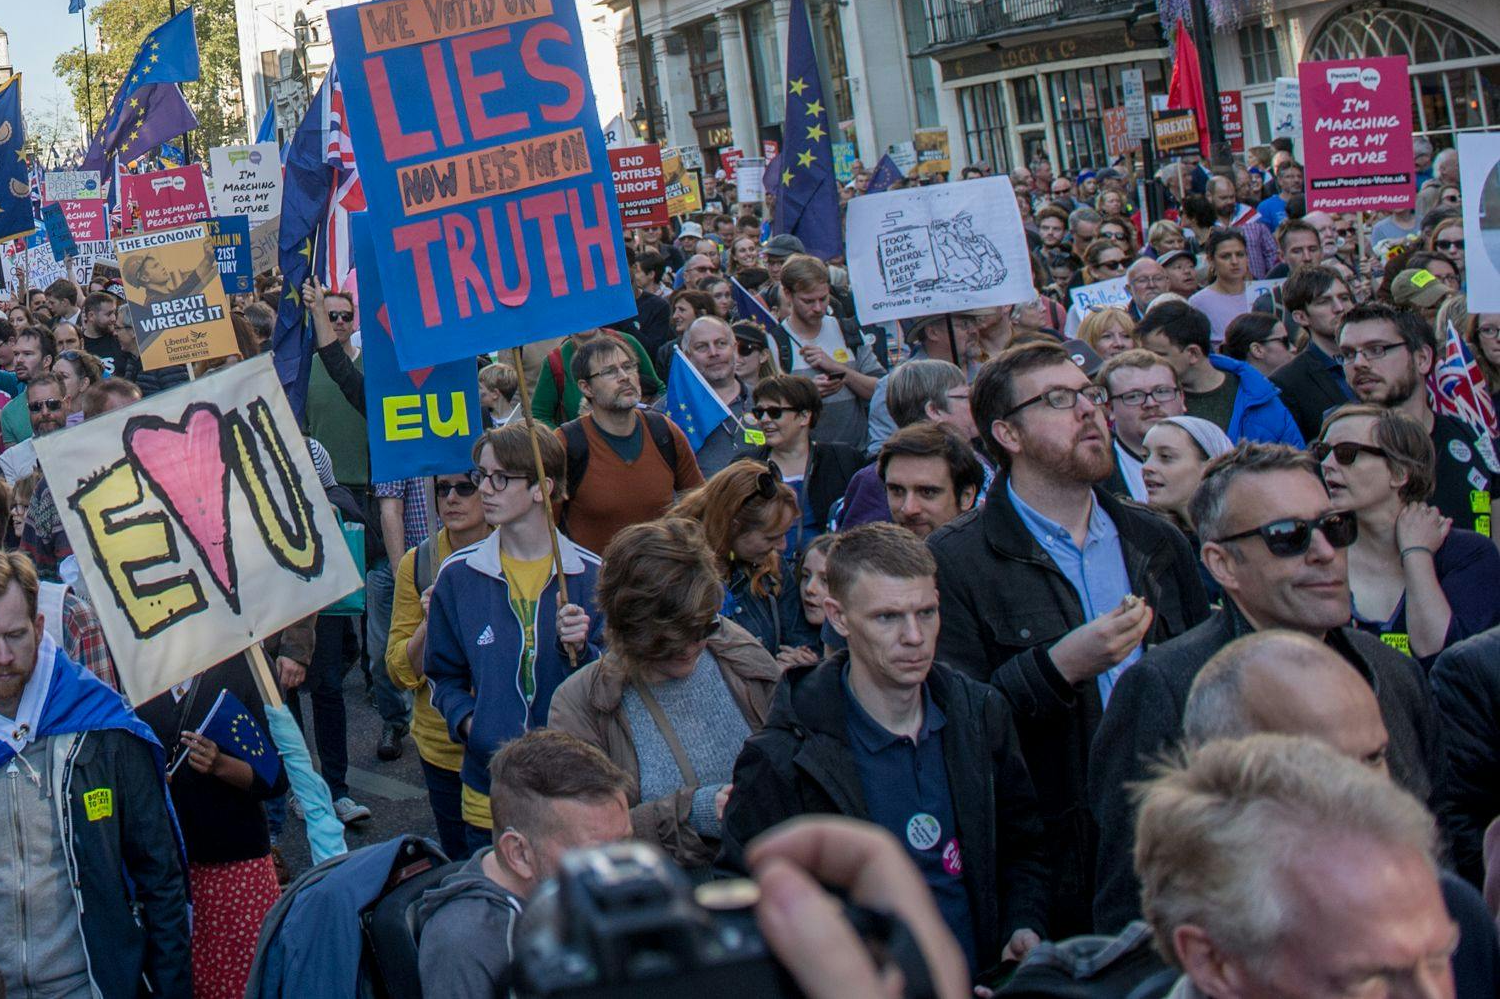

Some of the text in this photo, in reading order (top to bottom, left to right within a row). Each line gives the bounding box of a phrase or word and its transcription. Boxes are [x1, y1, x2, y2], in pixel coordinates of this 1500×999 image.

[366, 3, 415, 45] WE
[1001, 48, 1040, 68] LOCK
[1331, 72, 1358, 80] People's
[363, 22, 585, 162] LIES
[1342, 98, 1369, 113] I'M
[1155, 118, 1193, 135] BREXIT
[1315, 115, 1400, 132] MARCHING
[1329, 133, 1388, 149] FOR MY
[619, 156, 644, 167] END
[1330, 151, 1388, 166] FUTURE
[239, 170, 256, 180] I'M
[401, 161, 458, 208] NOW
[522, 140, 560, 181] VOTE
[561, 132, 589, 171] ON
[612, 167, 662, 181] ORTRESS
[223, 181, 276, 192] MARCHING
[614, 180, 658, 194] EUROPE
[1314, 174, 1407, 188] www.Peoples-Vote.uk
[232, 193, 269, 203] FOR MY
[626, 196, 665, 208] MOVEMENT
[66, 202, 81, 210] I'M
[146, 208, 162, 218] WE
[163, 204, 197, 215] DEMAND
[234, 204, 269, 213] FUTURE
[66, 211, 97, 220] RCHING
[147, 210, 208, 228] PEOPLE'S VOTE
[78, 221, 91, 229] MY
[118, 227, 203, 251] THE ECONOMY
[234, 233, 242, 245] IN
[883, 233, 912, 246] TOOK
[217, 247, 236, 260] 21ST
[392, 182, 620, 328] TRUTH
[886, 242, 915, 257] BACK
[75, 257, 91, 267] THE
[217, 261, 238, 274] TURY
[889, 261, 921, 277] PLEASE
[76, 267, 92, 285] OF
[892, 271, 915, 285] HELP
[151, 294, 206, 317] BREXIT
[914, 296, 931, 304] Eye
[140, 305, 222, 333] WRECKS IT
[164, 337, 189, 347] Liberal
[166, 341, 209, 354] Democrats
[382, 391, 470, 442] EU
